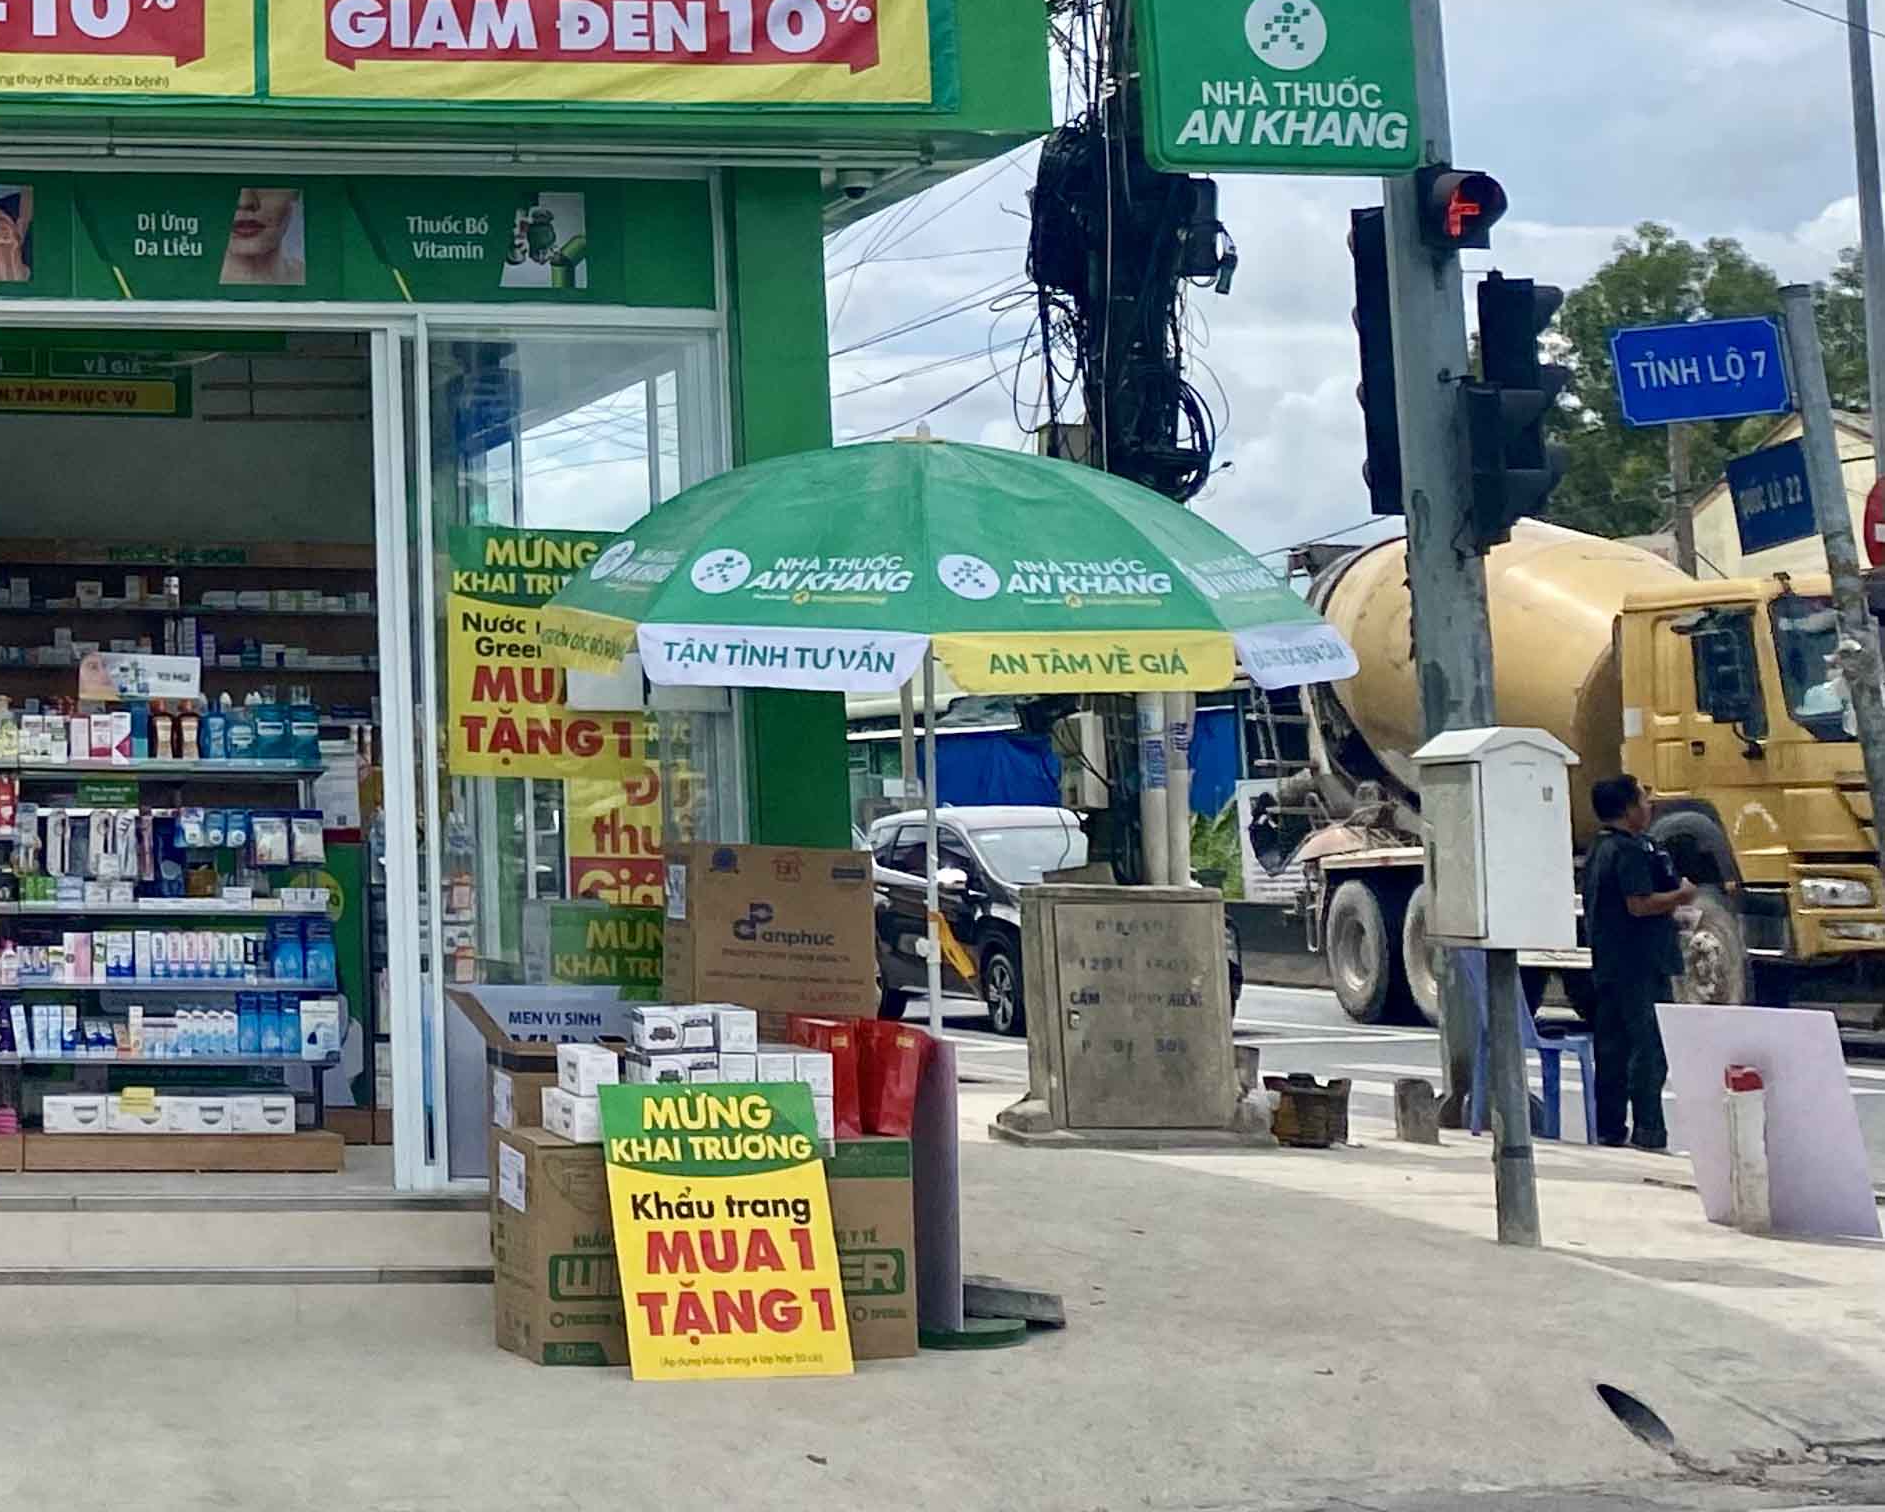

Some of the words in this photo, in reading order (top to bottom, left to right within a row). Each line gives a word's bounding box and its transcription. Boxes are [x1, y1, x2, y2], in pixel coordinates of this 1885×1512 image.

[1201, 75, 1269, 106] NHÀ
[1273, 75, 1383, 109] THUỐC
[1175, 109, 1247, 146] AN
[1251, 110, 1410, 150] KHANG
[159, 209, 199, 236] Ứng
[405, 215, 465, 235] Thuốc
[134, 237, 160, 257] Da
[412, 240, 484, 259] Vitamin
[1629, 349, 1701, 389] TỈNH
[1709, 345, 1746, 389] LỘ
[1752, 350, 1767, 379] 7
[453, 570, 516, 594] KHAI
[796, 571, 915, 593] KHANG
[1057, 573, 1173, 595] KHANG
[462, 611, 527, 635] Nước
[663, 638, 719, 669] TẬN
[724, 638, 789, 670] TÌNH
[794, 648, 835, 670] TƯ
[837, 643, 896, 675] VẤN
[989, 652, 1029, 675] AN
[1028, 646, 1092, 675] TÂM
[1095, 644, 1143, 676] VỀ
[1147, 647, 1189, 677] GIÁ
[471, 664, 568, 705] MU
[460, 706, 605, 766] TẶNG
[611, 719, 633, 759] 1
[507, 1010, 544, 1027] MEN
[546, 1011, 560, 1027] VI
[562, 1012, 602, 1028] SINH
[642, 1088, 774, 1132] MỪNG
[610, 1135, 683, 1164] KHAI
[688, 1132, 814, 1163] TRƯƠNG
[630, 1186, 715, 1222] Khẩu
[725, 1193, 813, 1225] trang
[645, 1229, 787, 1275] MUA
[790, 1227, 816, 1272] 1
[636, 1280, 805, 1347] TẶNG
[810, 1287, 837, 1332] 1
